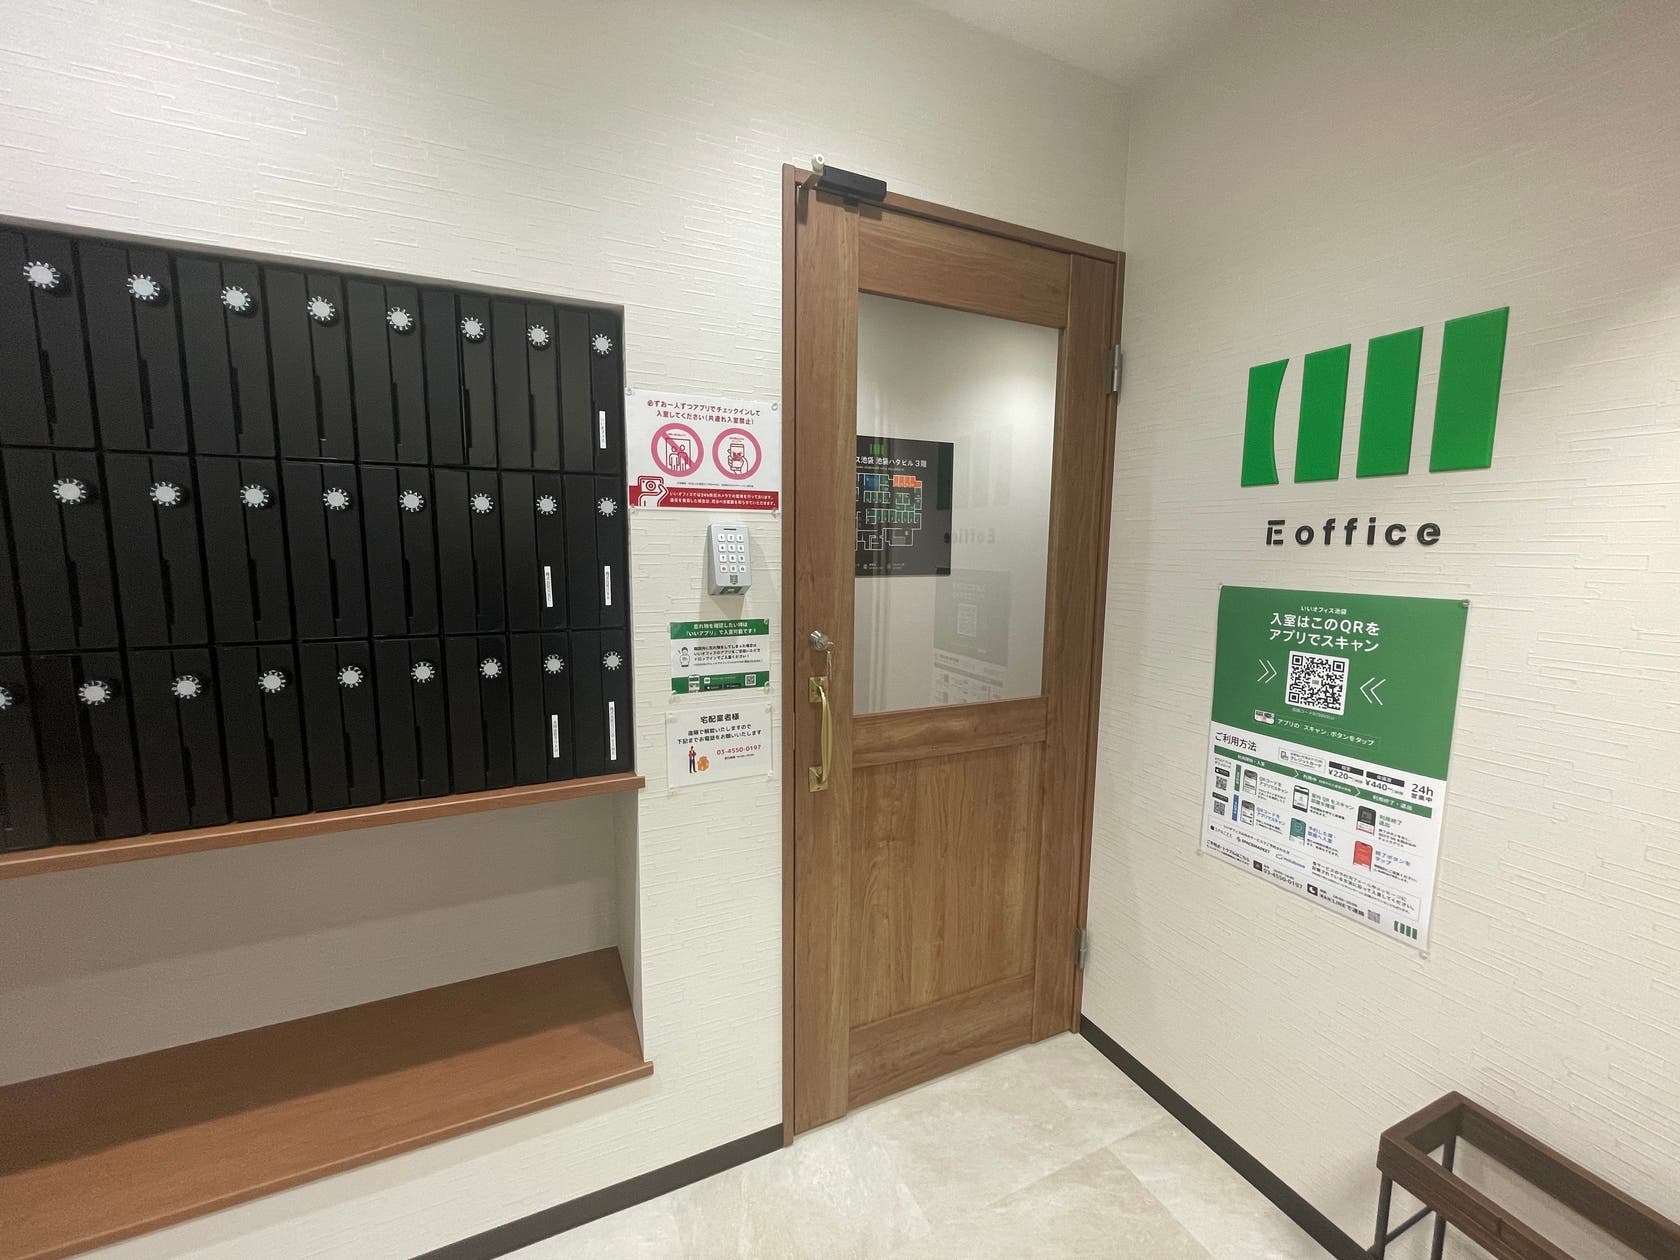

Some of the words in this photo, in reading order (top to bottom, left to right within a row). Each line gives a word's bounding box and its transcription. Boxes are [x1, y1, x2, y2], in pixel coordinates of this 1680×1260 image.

[647, 400, 760, 416] 必ずお一人ずつアプリでチェックインして
[1266, 517, 1441, 545] Eoffice
[1270, 612, 1380, 637] 入室はこのQRを
[1269, 628, 1380, 653] アプリでスキャン
[700, 713, 740, 724] 宅配業者様
[1215, 732, 1257, 752] ご利用方法
[1411, 783, 1434, 797] 24h
